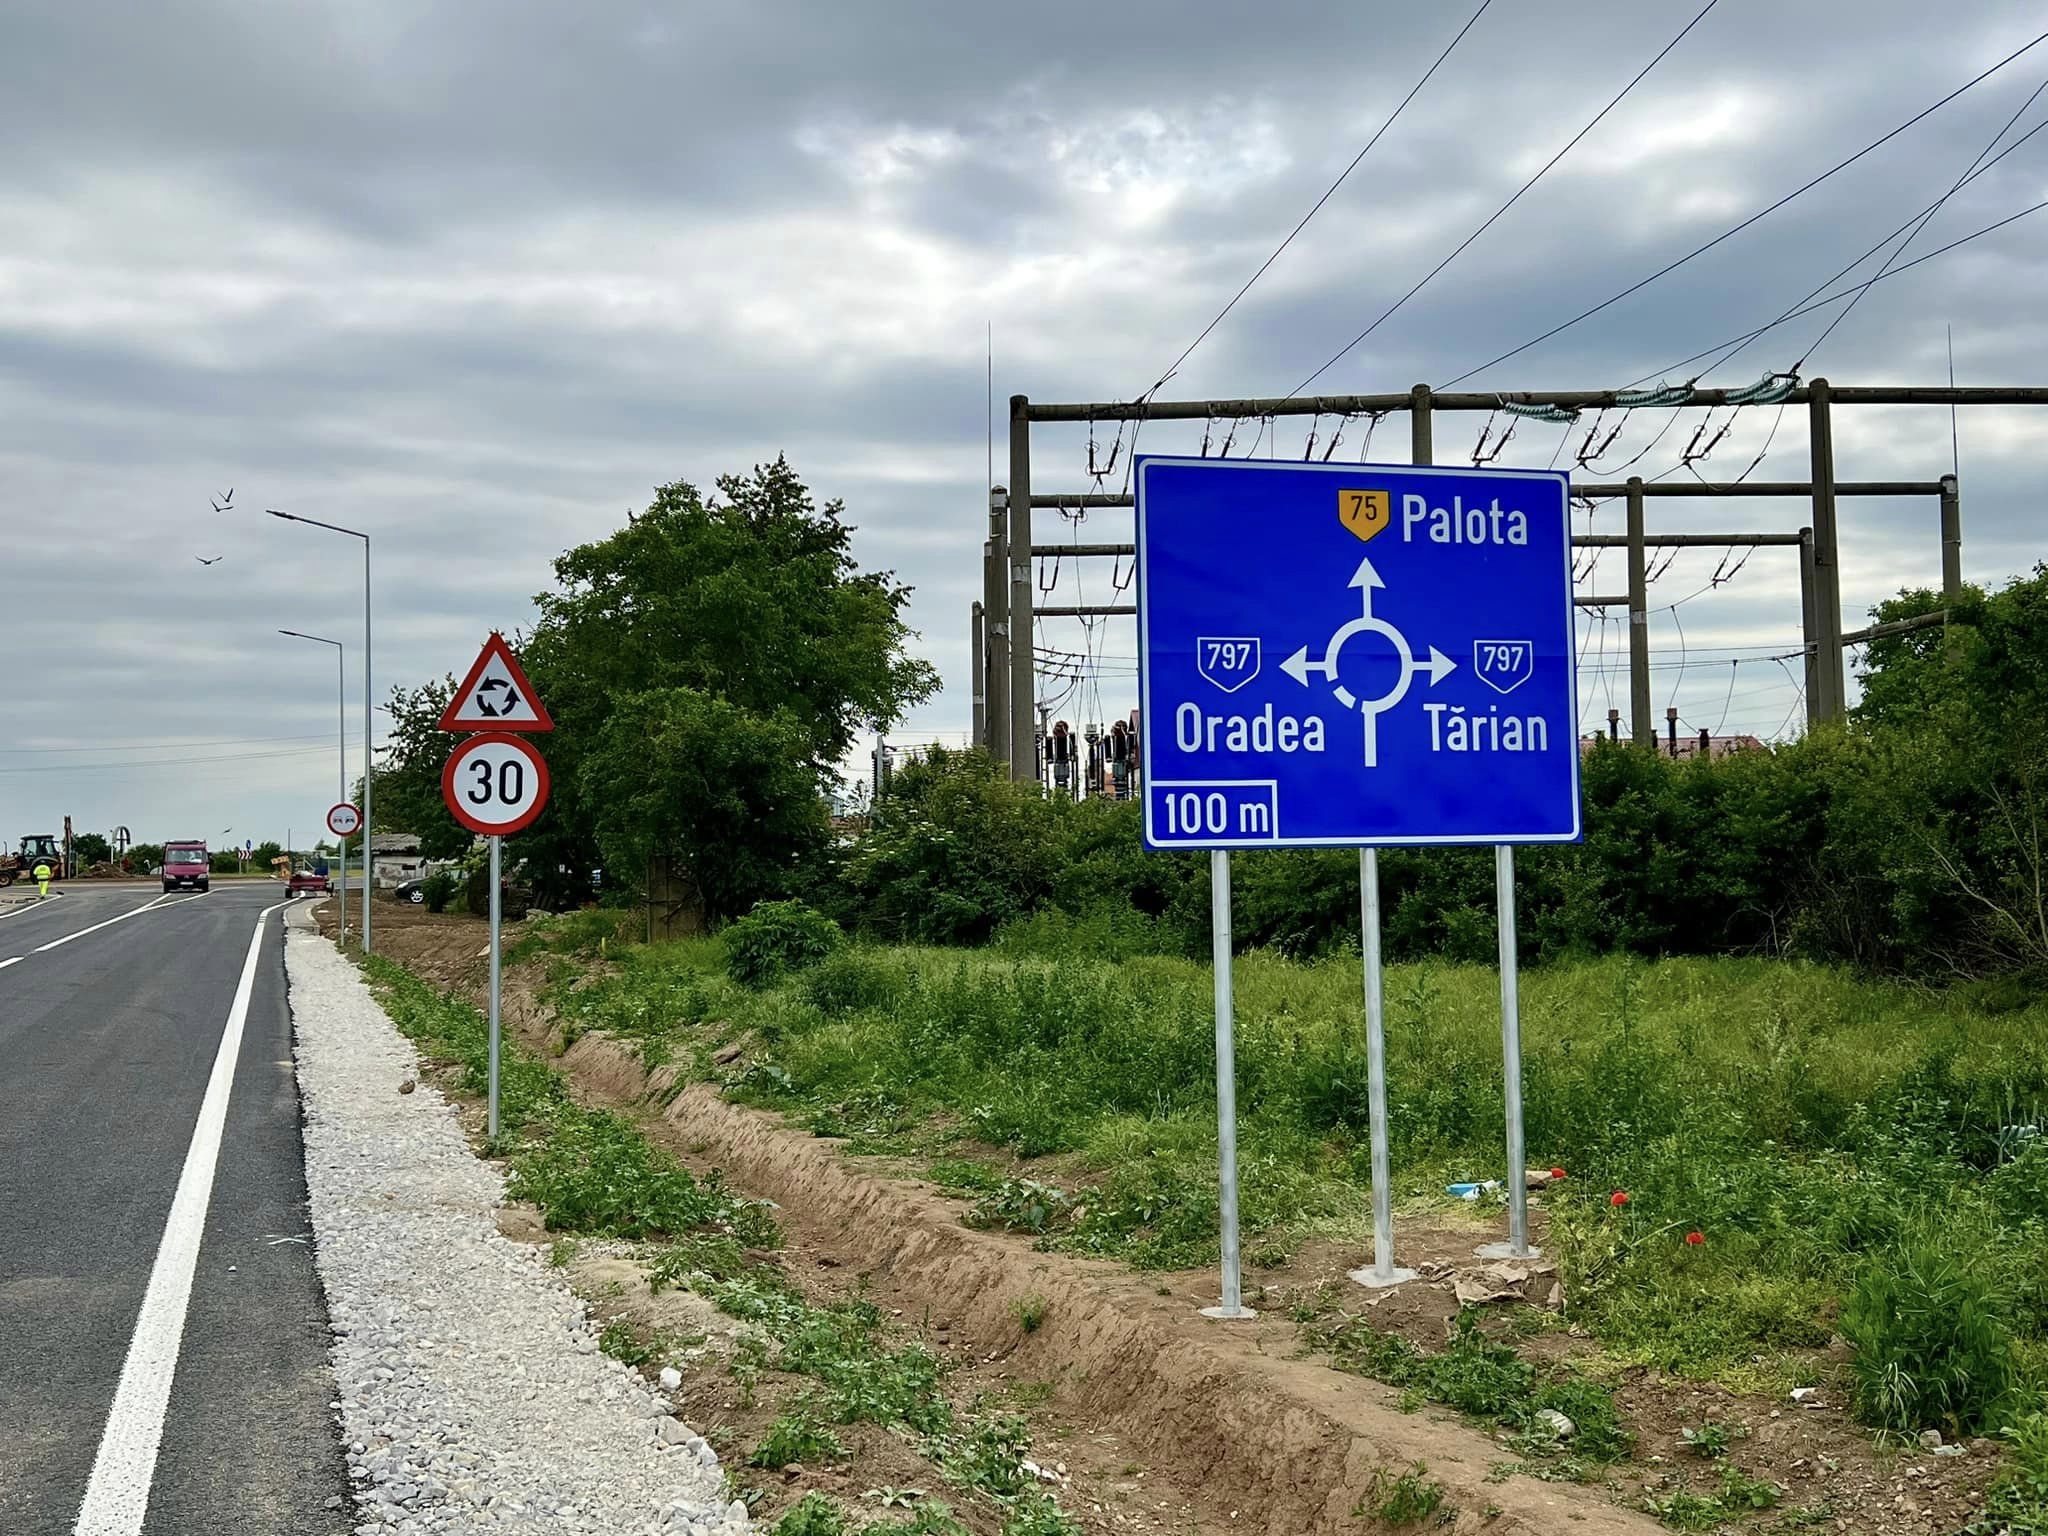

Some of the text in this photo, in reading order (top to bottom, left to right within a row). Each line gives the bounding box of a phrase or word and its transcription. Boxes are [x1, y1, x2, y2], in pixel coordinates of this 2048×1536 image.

[1350, 495, 1378, 521] 75
[1402, 494, 1528, 545] Palota
[1207, 643, 1250, 671] 797
[1483, 646, 1524, 672] 797
[1176, 702, 1325, 753] Oradea
[1423, 703, 1548, 752] Tărian
[467, 759, 523, 805] 30
[1165, 793, 1268, 834] 100 m
